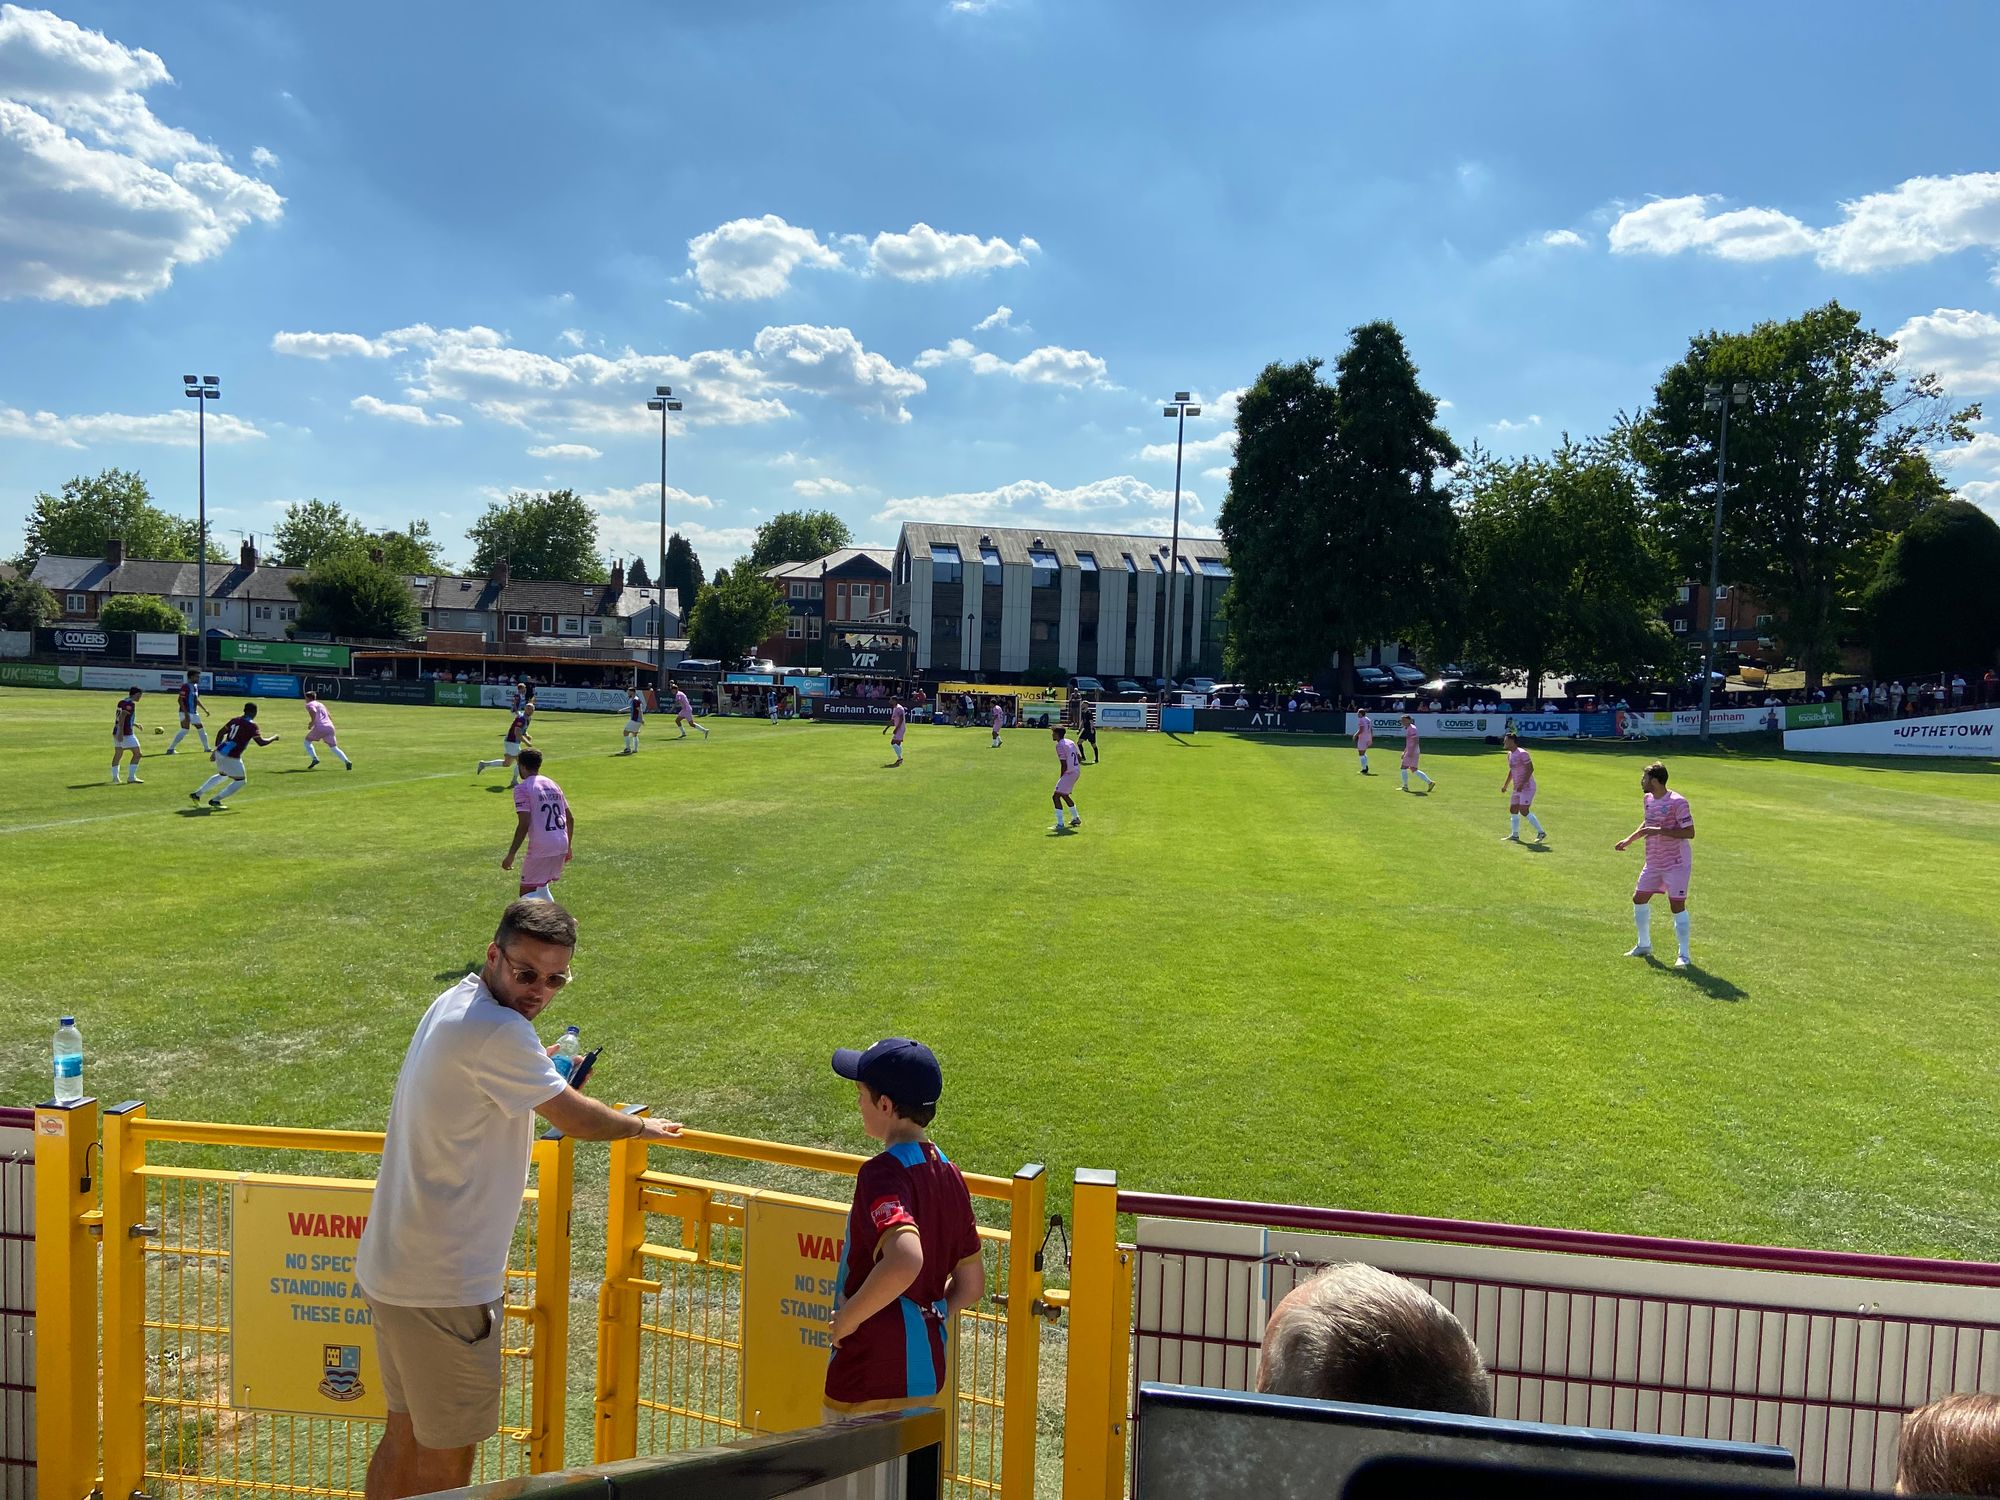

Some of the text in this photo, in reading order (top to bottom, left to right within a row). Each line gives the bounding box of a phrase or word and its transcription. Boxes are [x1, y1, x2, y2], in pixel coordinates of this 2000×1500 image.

[65, 633, 105, 644] COVERS
[2, 667, 20, 680] UK
[310, 683, 332, 694] LFM
[577, 691, 629, 705] PAPAY
[824, 704, 865, 714] Farnham
[868, 705, 892, 715] Town
[1707, 712, 1745, 721] arnham
[1444, 720, 1474, 728] COVERS
[1893, 724, 1994, 738] #UPTHETOWN
[229, 724, 239, 740] 11
[540, 803, 566, 831] 28
[287, 1212, 368, 1239] WARN
[285, 1253, 356, 1273] NO SPEC
[270, 1277, 347, 1298] STANDING
[794, 1274, 815, 1293] NO
[290, 1303, 372, 1325] THESE GAT
[800, 1327, 832, 1348] THES
